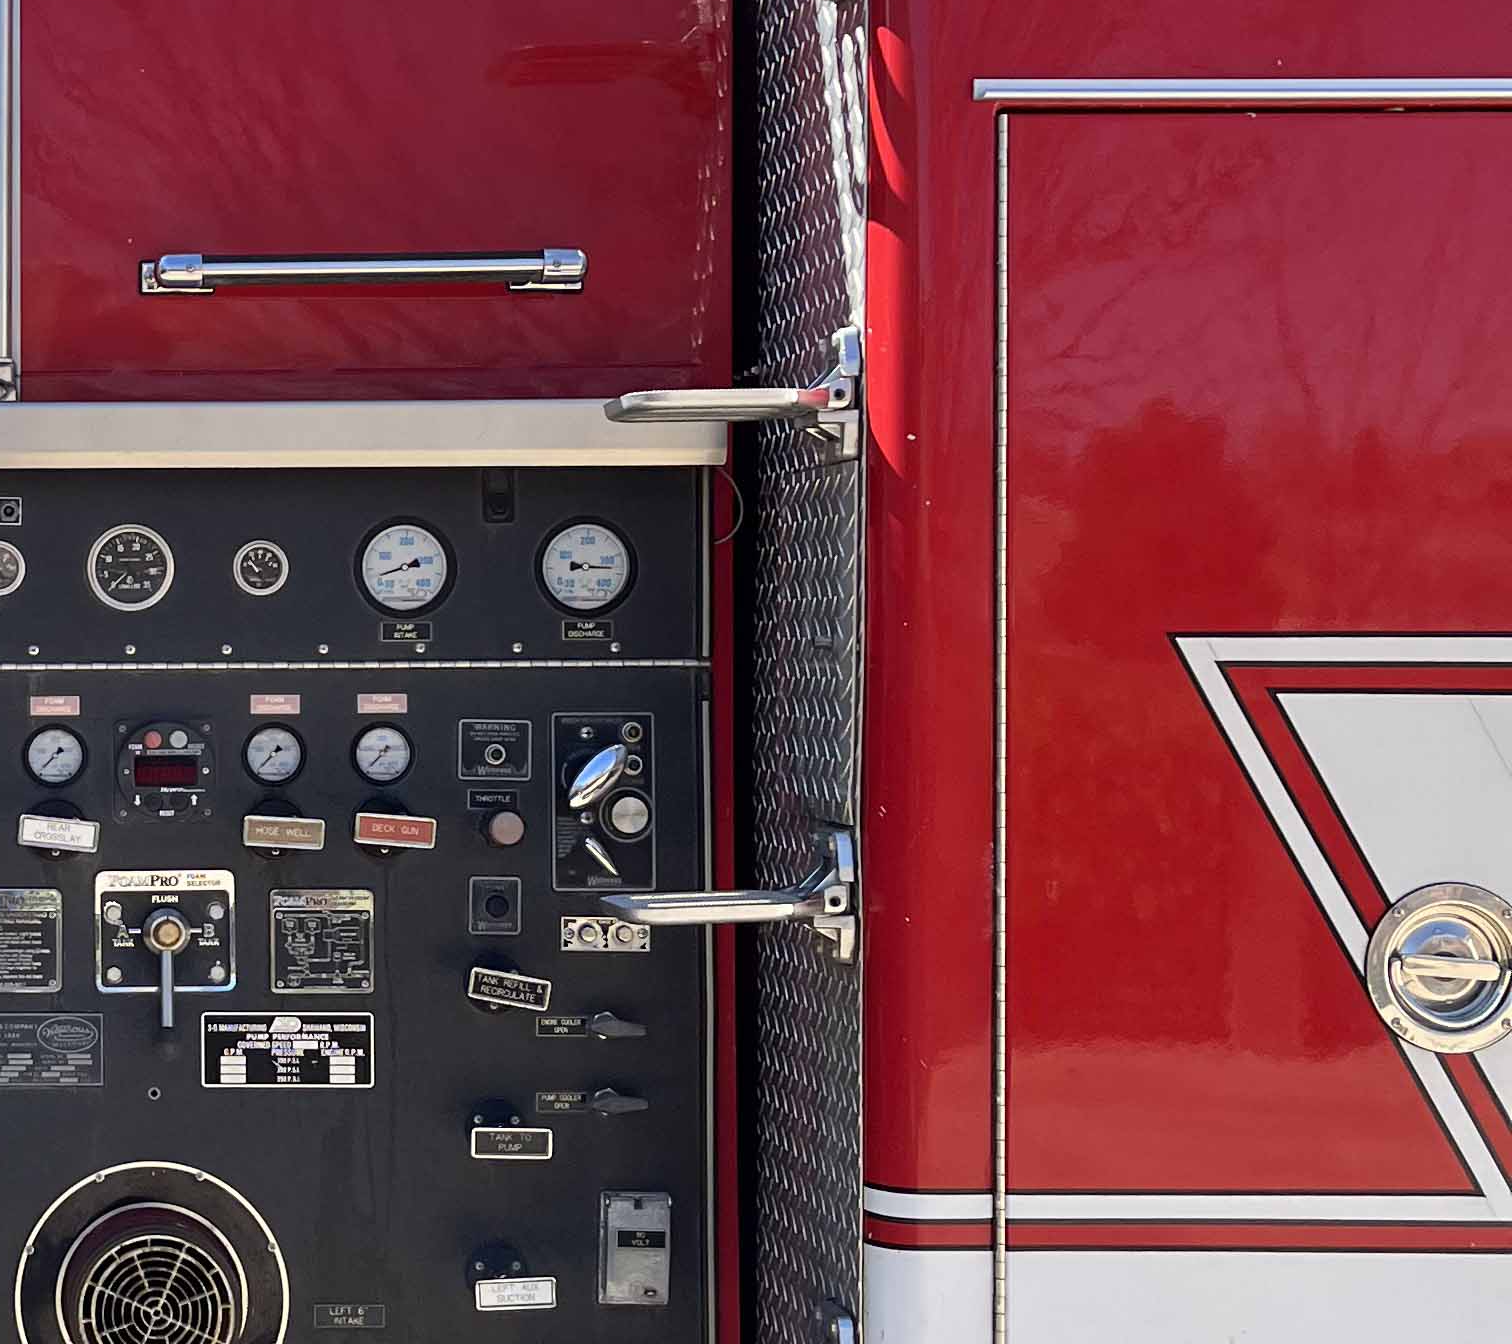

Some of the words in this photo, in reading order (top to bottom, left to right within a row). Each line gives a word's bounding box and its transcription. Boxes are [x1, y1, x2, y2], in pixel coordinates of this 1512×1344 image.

[567, 630, 605, 638] DISCHARGE
[46, 822, 71, 832] REAR
[255, 826, 281, 836] HOSE
[285, 827, 312, 838] WELL
[371, 823, 396, 834] DECK
[400, 824, 420, 836] GUN
[33, 832, 82, 844] CROSSLAY
[152, 895, 179, 904] FLUSH
[117, 924, 129, 938] A
[203, 924, 215, 938] B
[112, 938, 135, 947] TANK
[197, 938, 219, 946] TANK
[478, 974, 500, 986] TANK
[504, 979, 531, 992] REFILL
[480, 984, 537, 1003] RECIRCULATE
[490, 1132, 513, 1142] TANK
[520, 1134, 532, 1142] TO
[498, 1143, 523, 1152] PUMP
[491, 1284, 514, 1293] LEFT
[496, 1294, 536, 1303] SUCTION
[329, 1306, 352, 1316] LEFT
[334, 1317, 366, 1326] INTAKE
